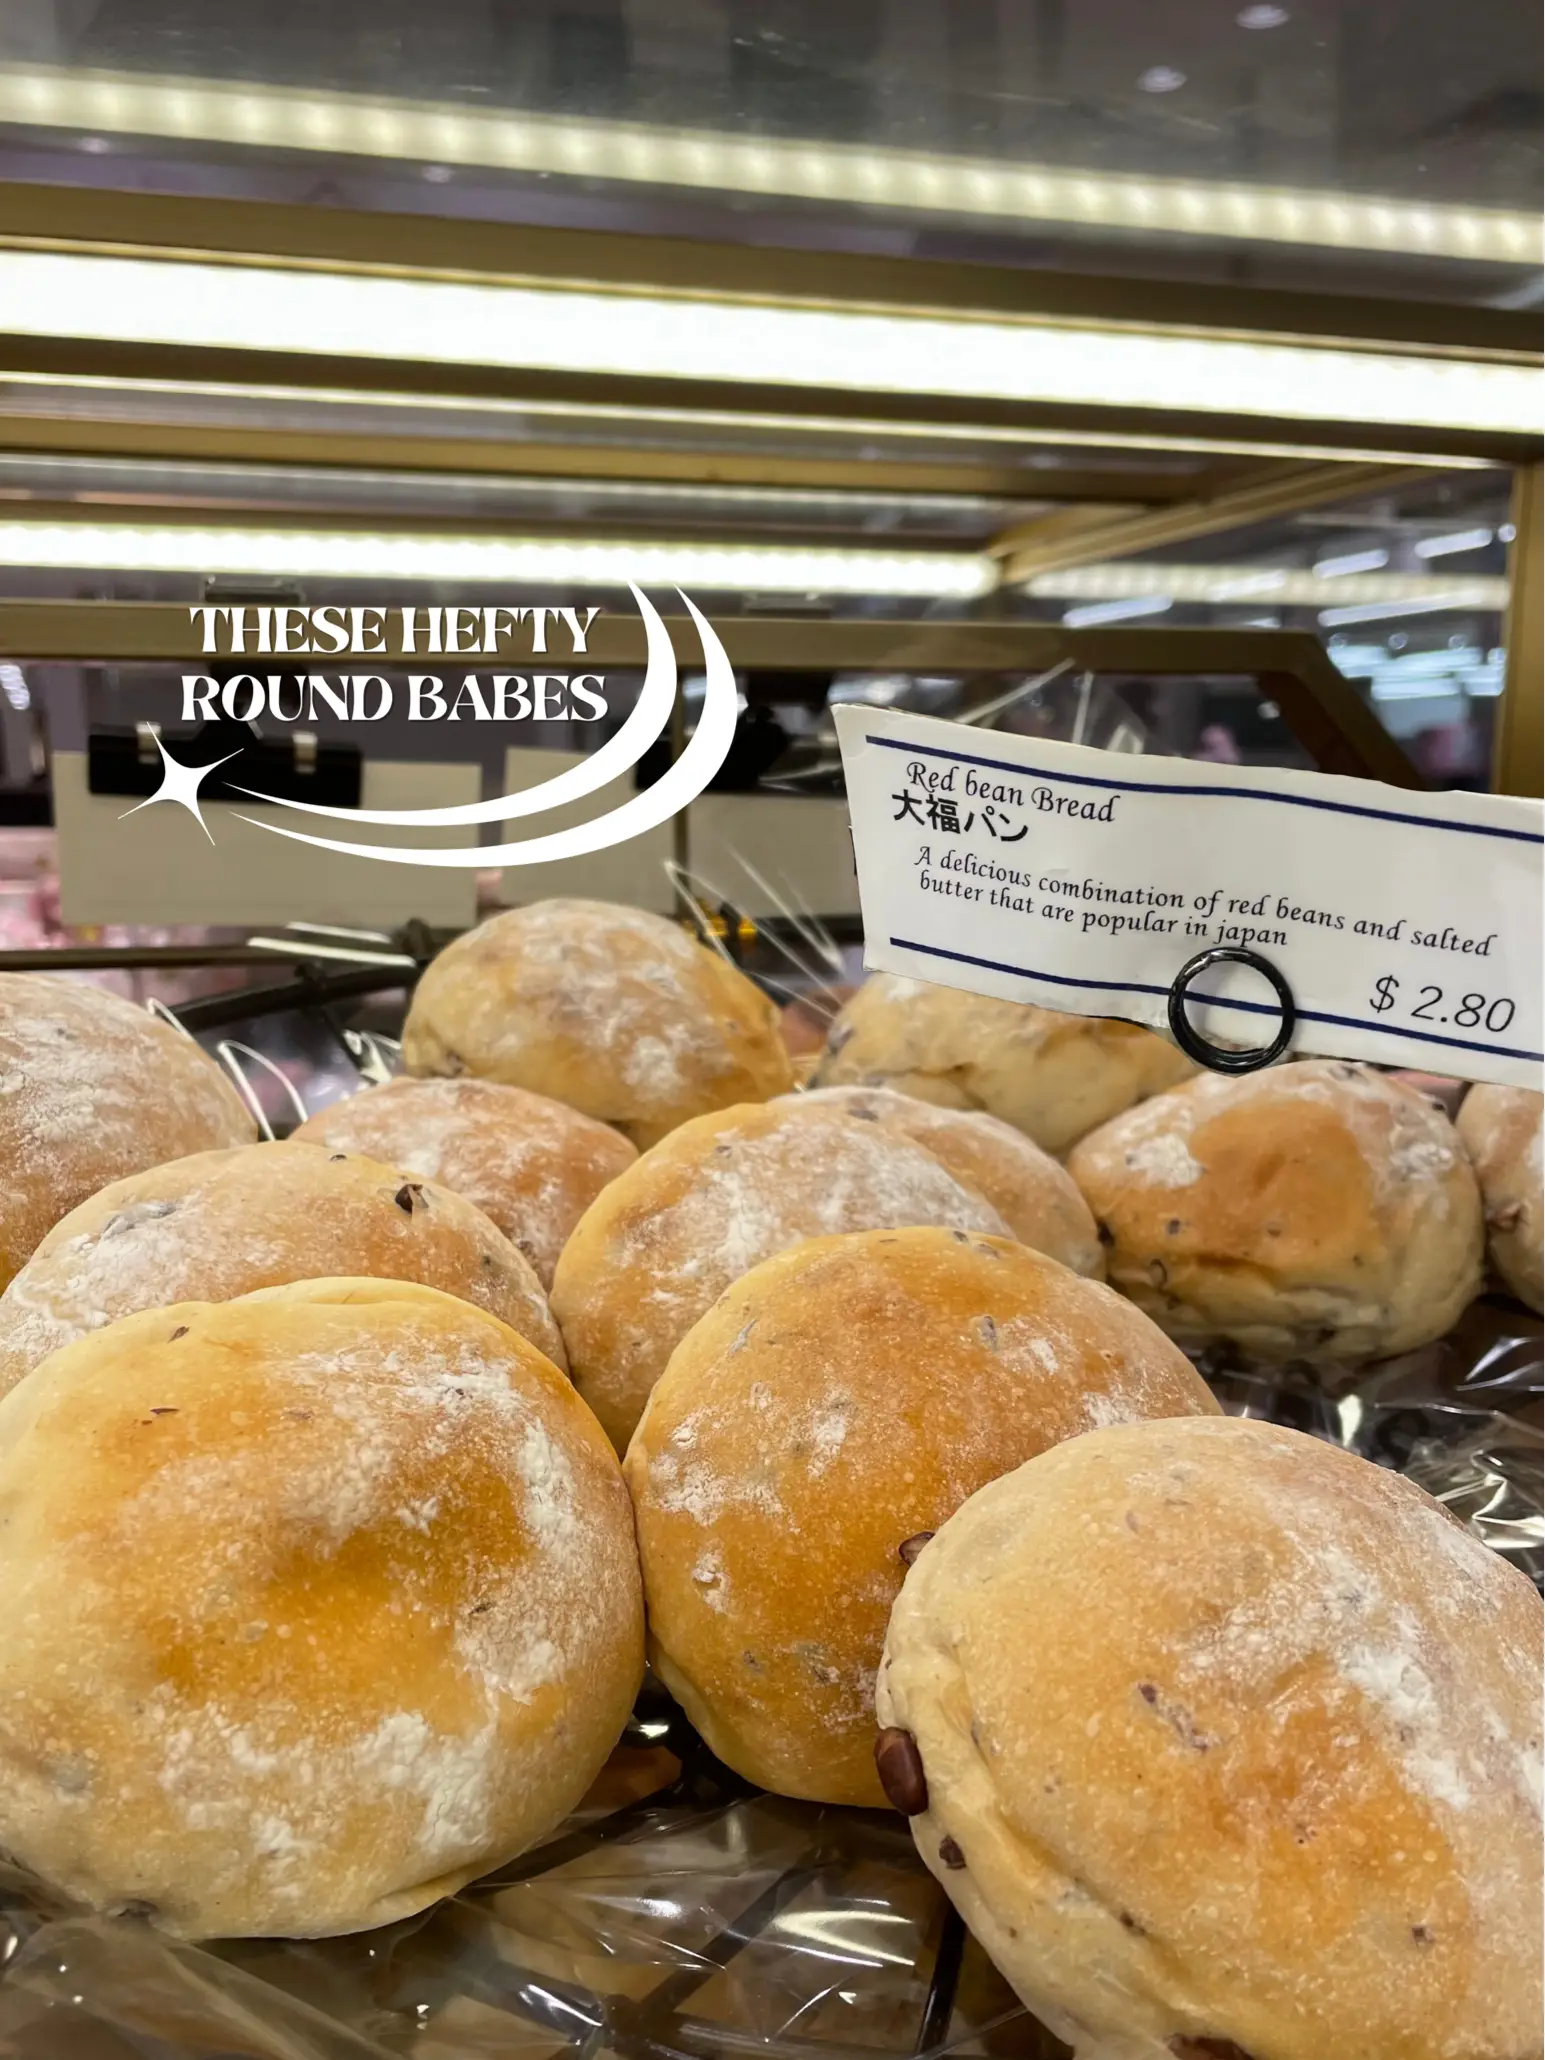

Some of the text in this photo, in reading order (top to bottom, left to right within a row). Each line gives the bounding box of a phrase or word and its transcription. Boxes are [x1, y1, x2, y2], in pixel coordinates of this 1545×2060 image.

[891, 788, 1029, 843] 大福パン
[906, 761, 1121, 823] Red bean Bread
[913, 845, 1499, 957] A delicious combination of red beans and salted
[919, 868, 1288, 948] butter that are popular in japan
[1368, 974, 1517, 1034] $ 2.80
